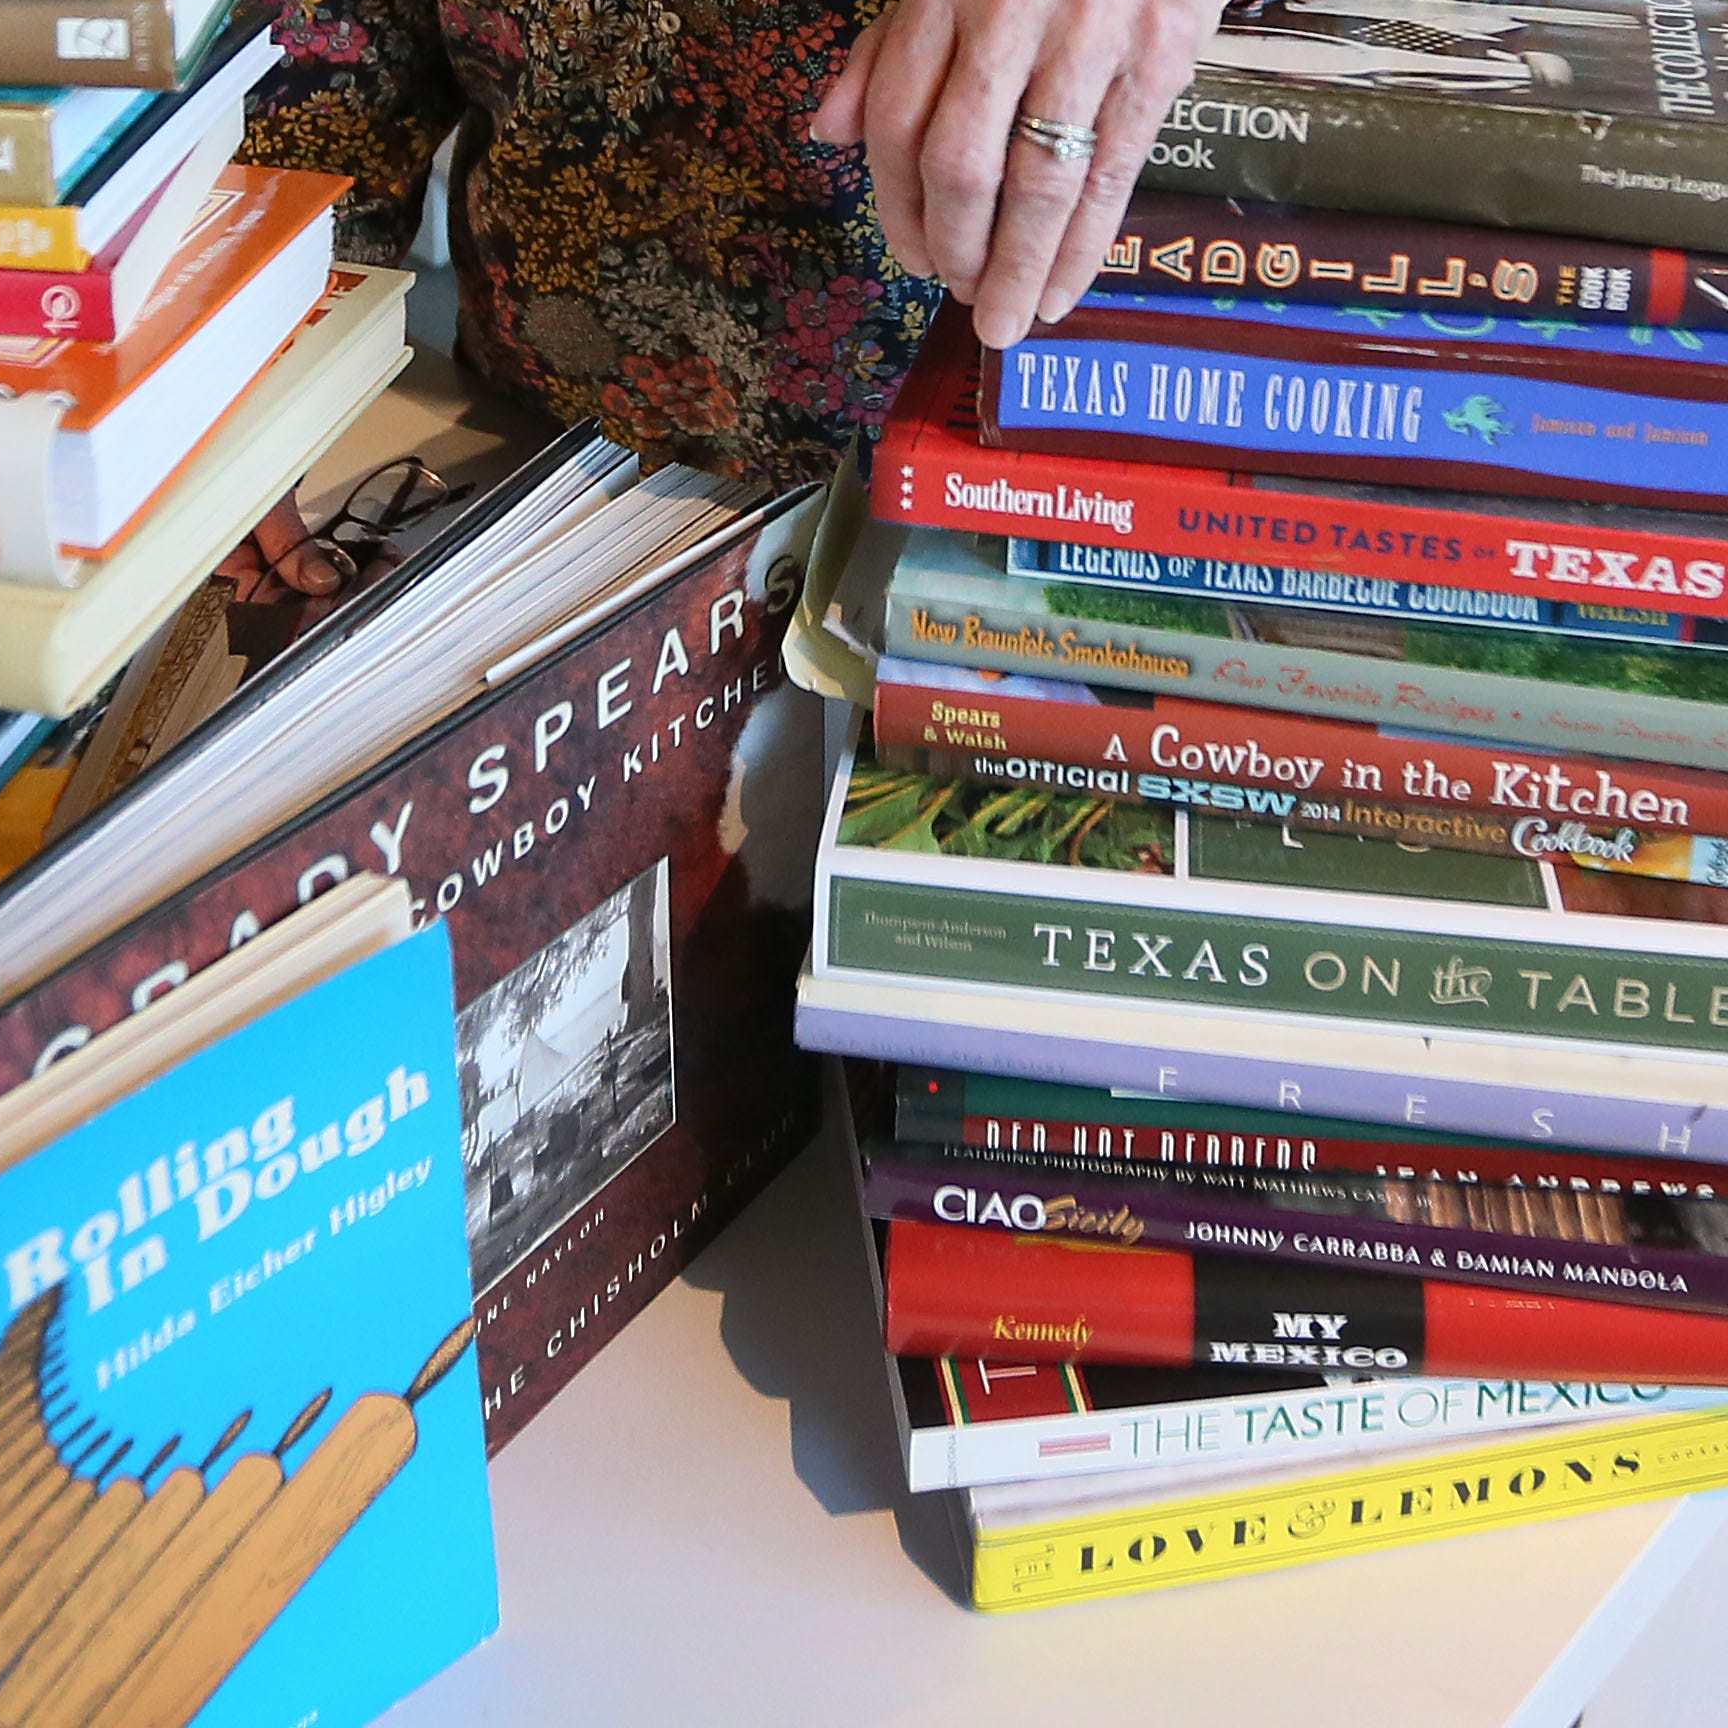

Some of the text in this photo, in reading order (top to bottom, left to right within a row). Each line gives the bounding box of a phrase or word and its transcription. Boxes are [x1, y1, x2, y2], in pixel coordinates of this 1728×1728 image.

[1614, 168, 1669, 191] Junior
[1577, 265, 1605, 311] COOK
[1605, 267, 1633, 312] BOOK
[1018, 351, 1425, 444] TEXAS HOME COOKING
[944, 473, 1725, 599] Southern Living UNITED TASTES TEXAS
[1058, 542, 1160, 582] LEGENDS
[1203, 555, 1273, 595] TEXAS
[1281, 568, 1400, 608] BARBECUE
[467, 552, 802, 816] SPEARS
[911, 609, 1191, 680] New Braunfels Smokehouse
[931, 700, 1002, 728] Spears
[944, 728, 1008, 752] Walsh
[1104, 724, 1690, 827] A Cowboy in the Kitchen
[407, 775, 600, 934] COWBOY
[1138, 775, 1635, 864] SXSW 2014 Interactive Cookbook
[923, 932, 973, 954] Wilson
[1033, 922, 1270, 987] TEXAS
[1303, 949, 1400, 997] ON
[1429, 955, 1493, 1007] the
[3, 1094, 297, 1312] Rolling
[82, 1064, 430, 1314] In Dough
[943, 1143, 1037, 1167] FEATURING
[1044, 1154, 1170, 1183] PHOTOGRAPHY
[1254, 1177, 1347, 1202] MATTHEWS
[94, 1155, 434, 1392] Hilda Eicher Higley
[546, 1192, 710, 1360] CHISHOLM
[932, 1184, 1049, 1232] CIAO
[1184, 1220, 1284, 1253] JOHNNY
[1293, 1232, 1422, 1265] CARRABBA
[1429, 1246, 1447, 1268] &
[1457, 1249, 1556, 1279] DAMIAN
[1562, 1262, 1690, 1294] MANDOLA
[990, 1314, 1095, 1351] Kennedy
[1209, 1340, 1409, 1370] MEXICO
[1272, 1312, 1349, 1340] MY
[1120, 1379, 1670, 1460] THE TASTE OF MEXICO
[1079, 1516, 1267, 1574] LOVE
[1286, 1499, 1336, 1540] &
[1350, 1449, 1643, 1527] LEMONS
